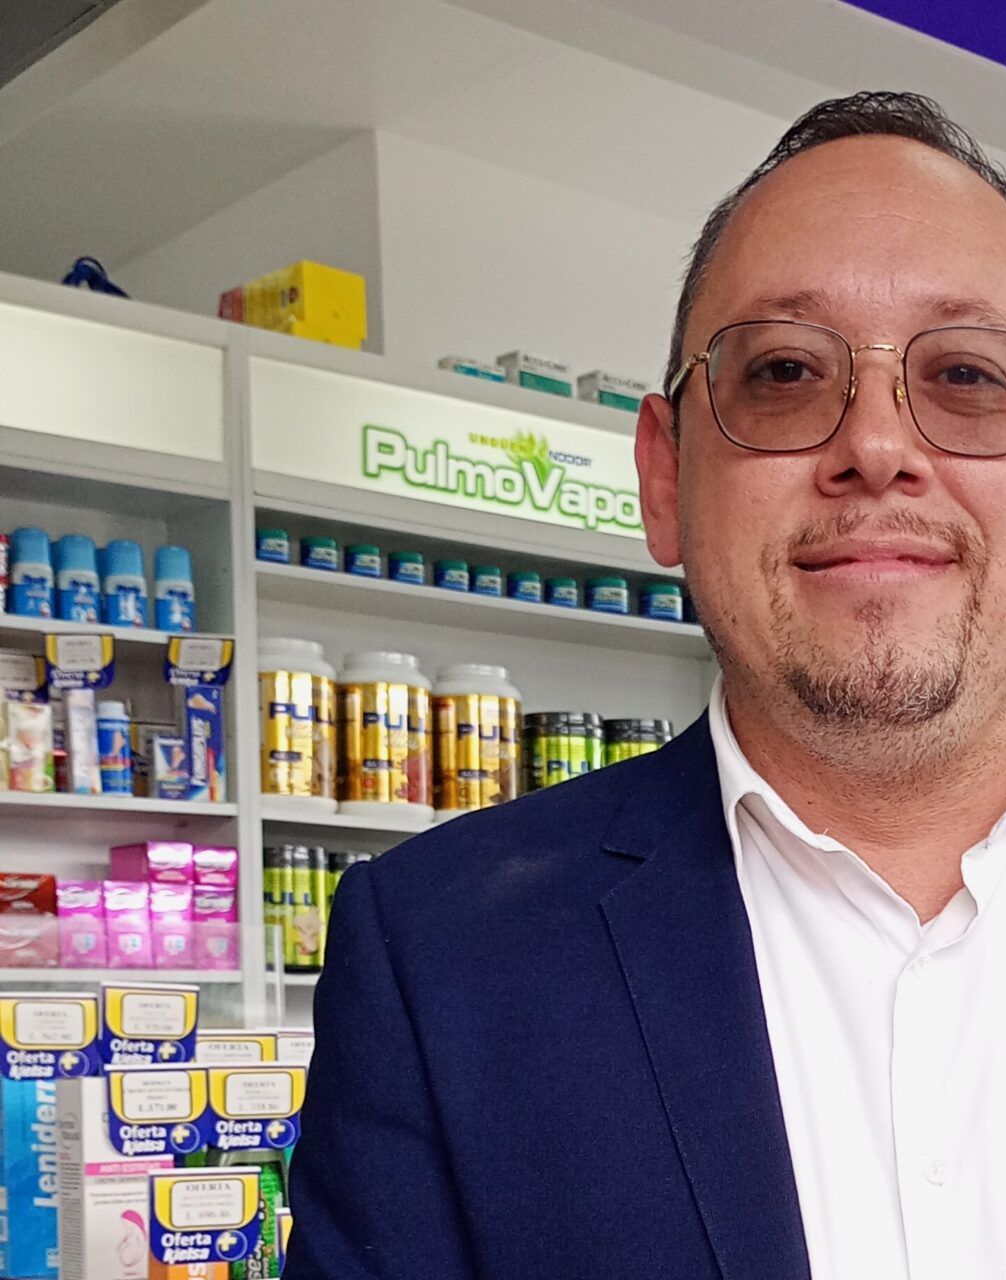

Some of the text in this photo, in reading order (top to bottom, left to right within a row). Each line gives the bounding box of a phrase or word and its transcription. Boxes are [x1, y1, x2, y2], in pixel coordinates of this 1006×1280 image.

[362, 424, 645, 530] PulmoVapo
[110, 1038, 155, 1053] Oferta
[6, 1051, 56, 1066] Oferta
[119, 1125, 167, 1140] Oferta
[215, 1120, 263, 1134] Oferta
[161, 1232, 212, 1248] Oferta
